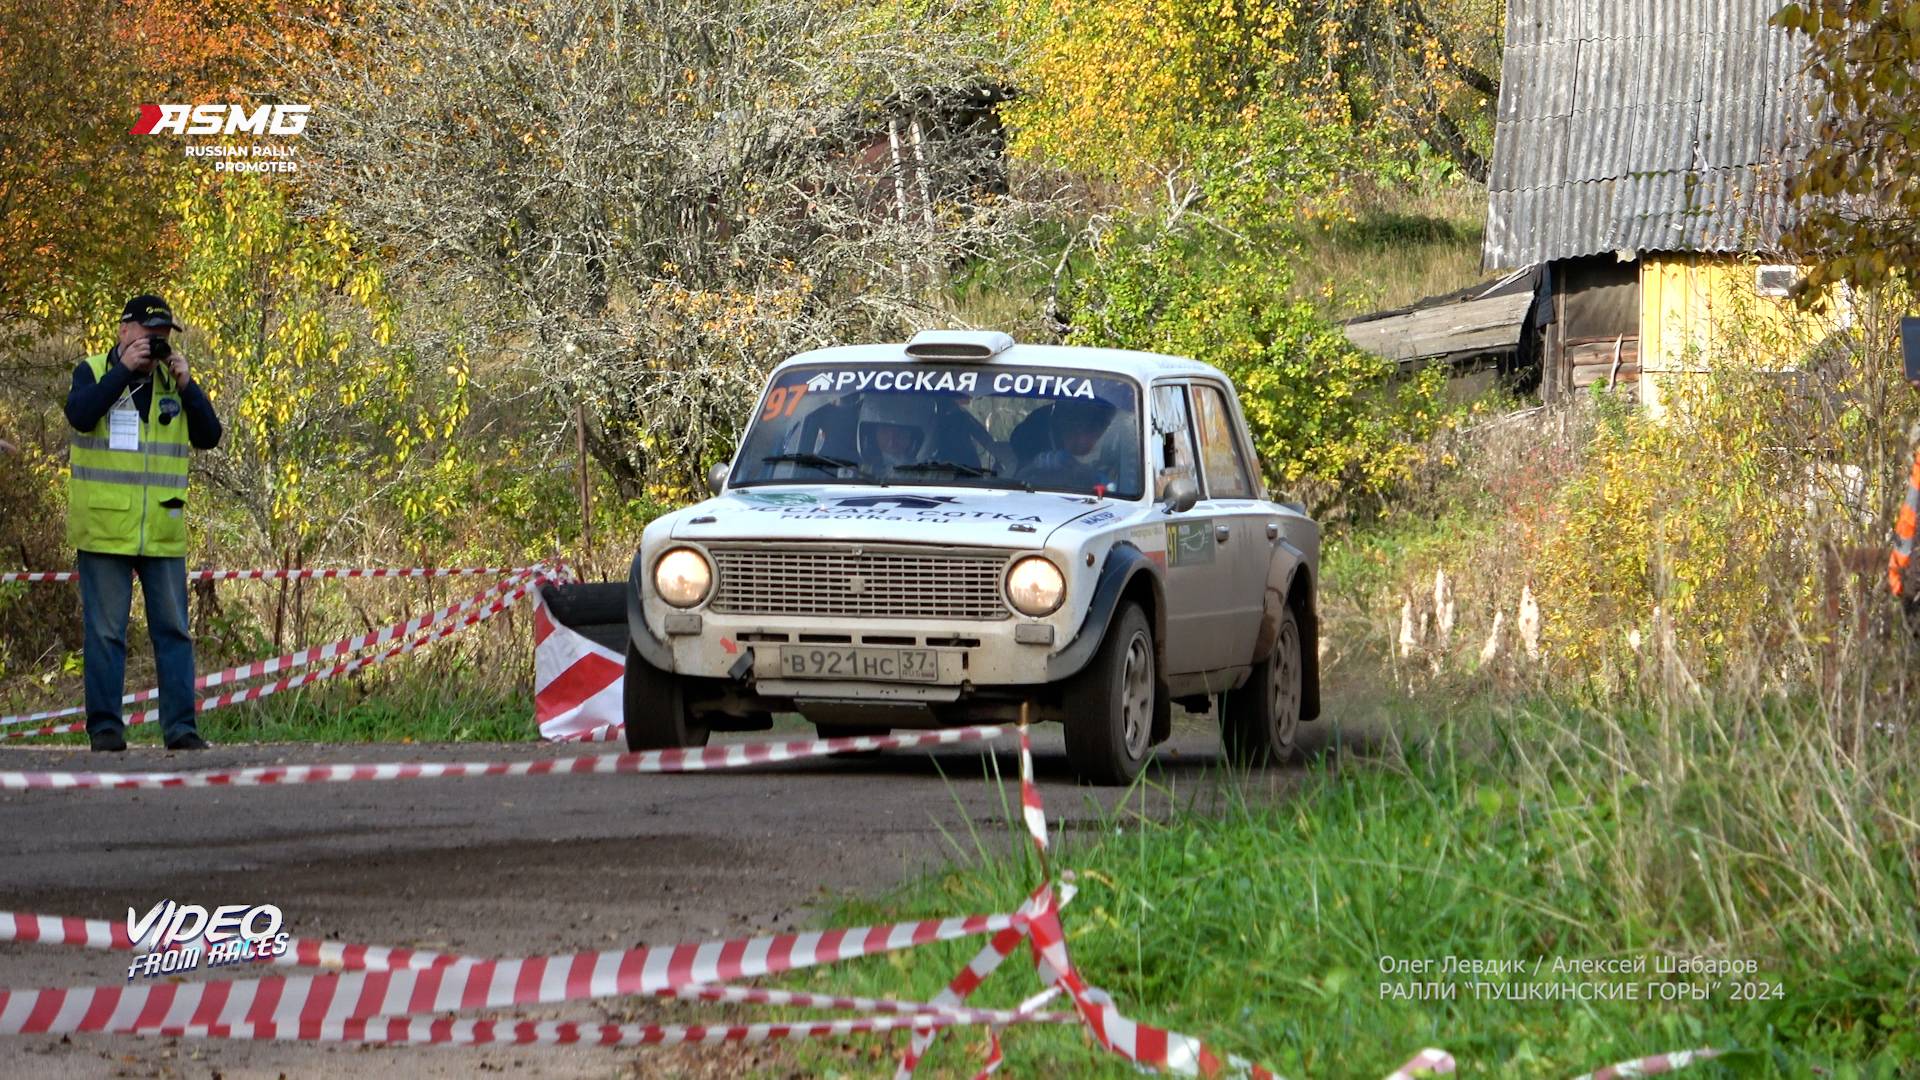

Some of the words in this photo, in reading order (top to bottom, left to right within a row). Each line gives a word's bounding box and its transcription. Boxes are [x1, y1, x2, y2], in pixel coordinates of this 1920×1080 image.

[835, 370, 978, 391] РУССКАЯ
[993, 373, 1095, 399] СОТКА
[761, 384, 808, 422] 97
[745, 506, 891, 514] ССКАЯ
[916, 510, 1042, 523] СОТКА
[902, 651, 928, 670] 37
